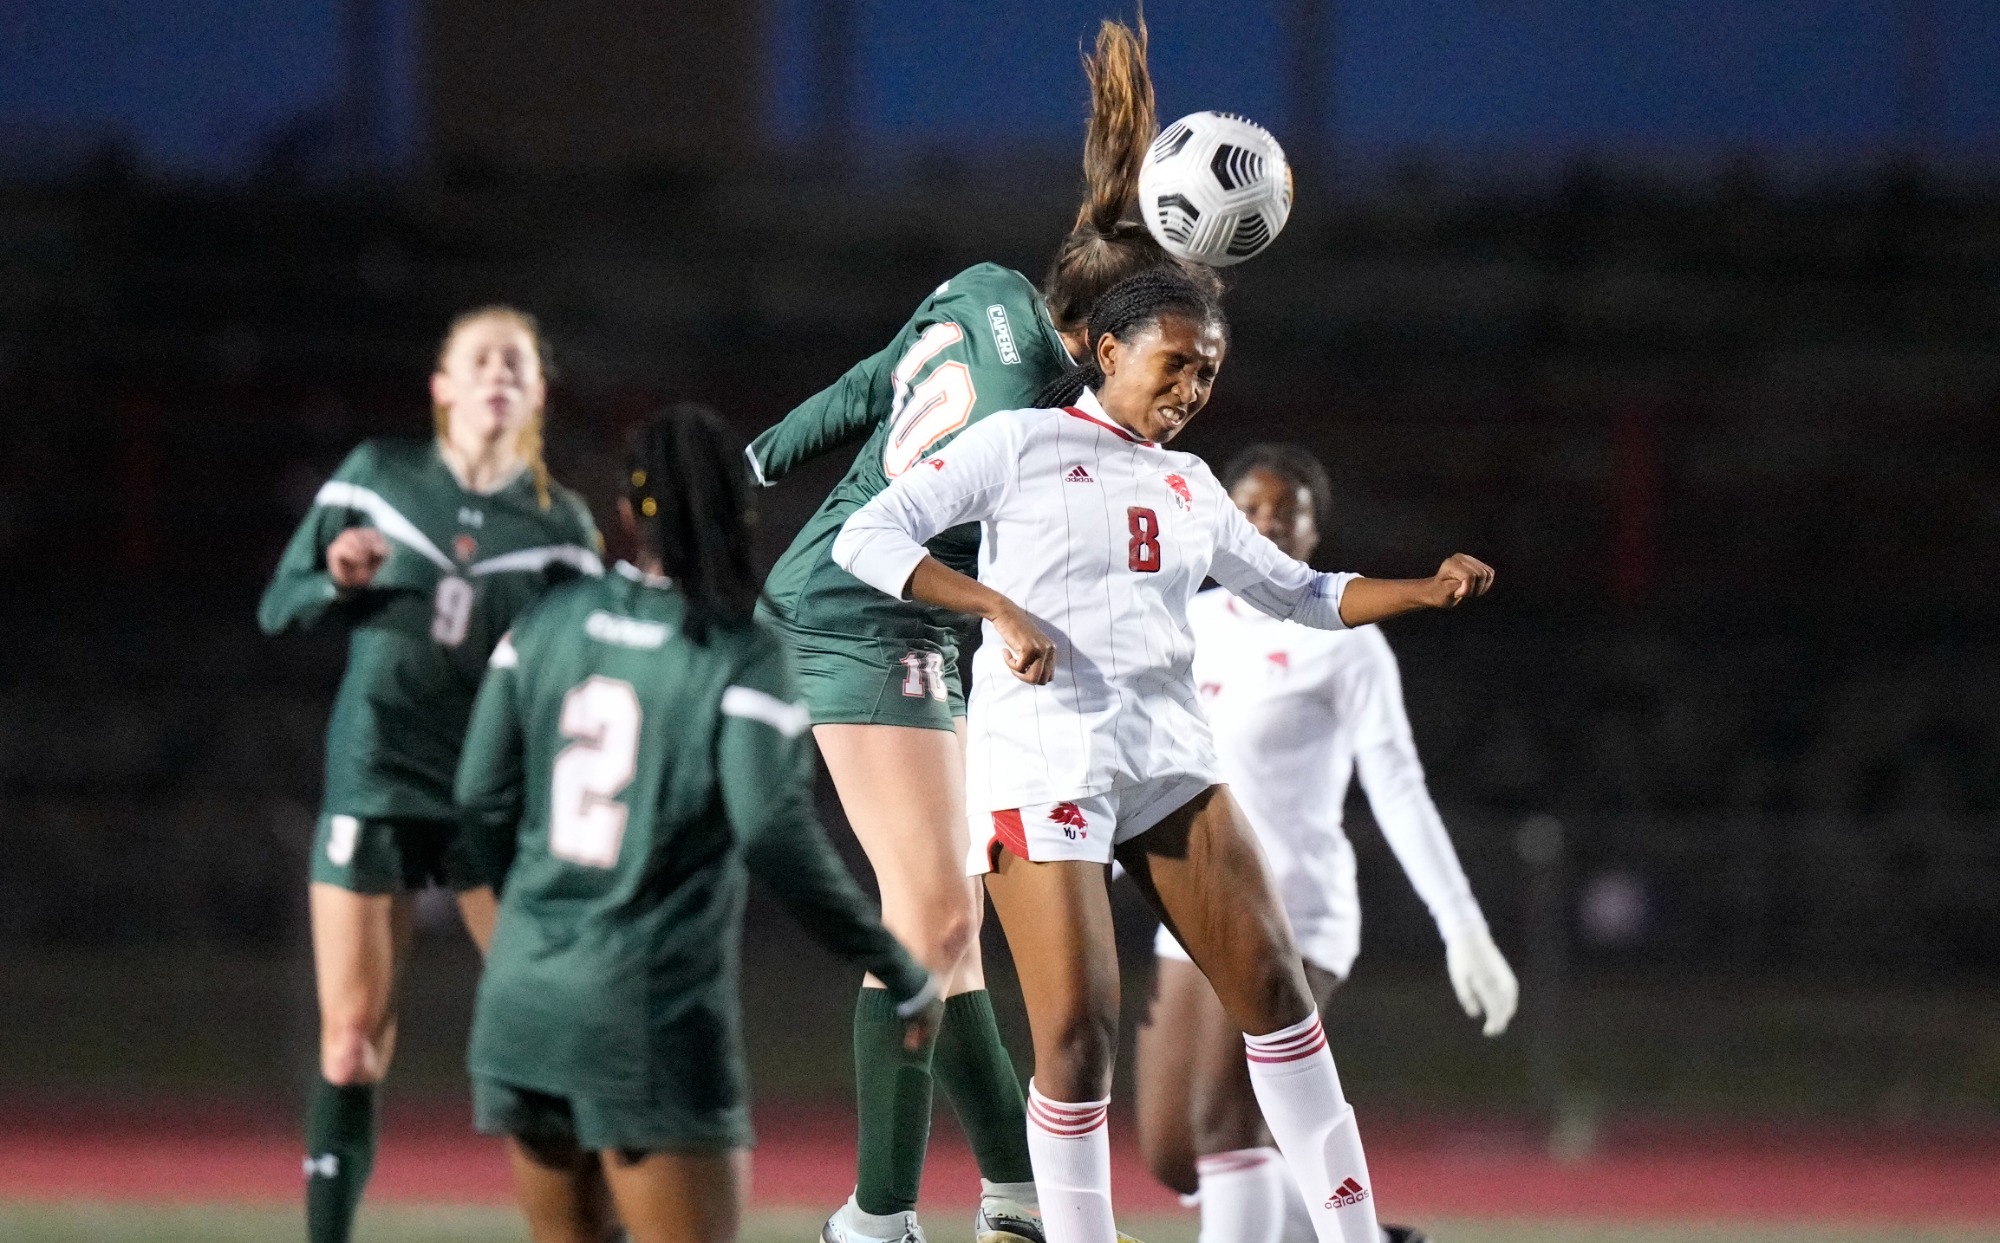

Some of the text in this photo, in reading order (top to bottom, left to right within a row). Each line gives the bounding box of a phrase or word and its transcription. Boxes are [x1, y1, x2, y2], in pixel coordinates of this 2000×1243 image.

[988, 305, 1019, 363] CAPERS
[884, 322, 977, 479] 10
[1127, 506, 1161, 573] 8
[433, 575, 474, 645] 9
[899, 650, 948, 702] 10
[550, 675, 642, 870] 2
[1063, 827, 1076, 840] YU
[1324, 1189, 1370, 1210] adidas
